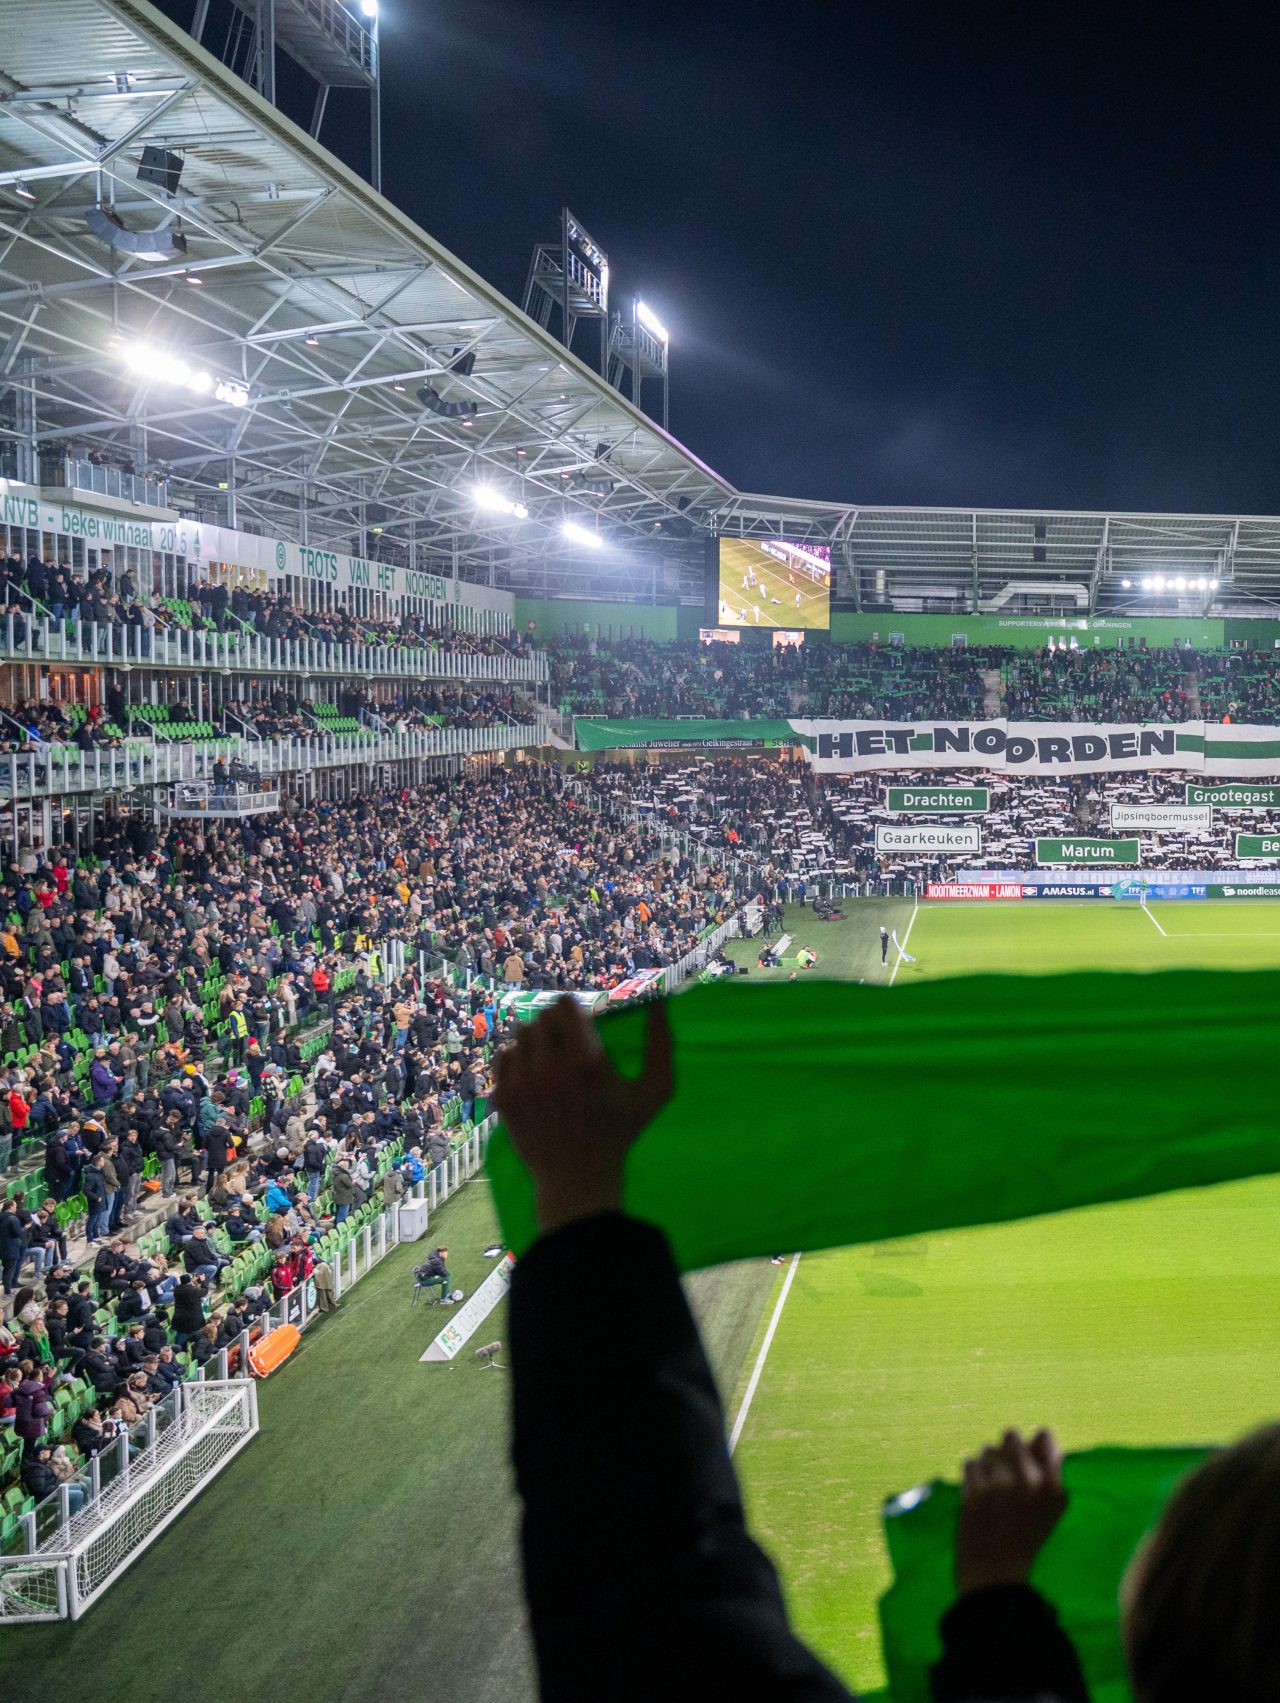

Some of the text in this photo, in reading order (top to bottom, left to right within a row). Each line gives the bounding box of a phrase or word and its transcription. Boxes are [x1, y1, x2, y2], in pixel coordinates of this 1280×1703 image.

[160, 527, 187, 554] 205
[299, 549, 447, 600] TROTS VAN HET NOORDEN
[818, 727, 1175, 764] HET NOORDEN
[903, 793, 973, 807] Drachten
[1193, 789, 1275, 805] Grootegast
[1114, 811, 1208, 822] Jipsingboermussel
[883, 831, 973, 846] Gaarkeuken
[1061, 844, 1115, 858] Marum
[996, 885, 1021, 897] LAMON
[1042, 887, 1094, 896] AMASUS.nl
